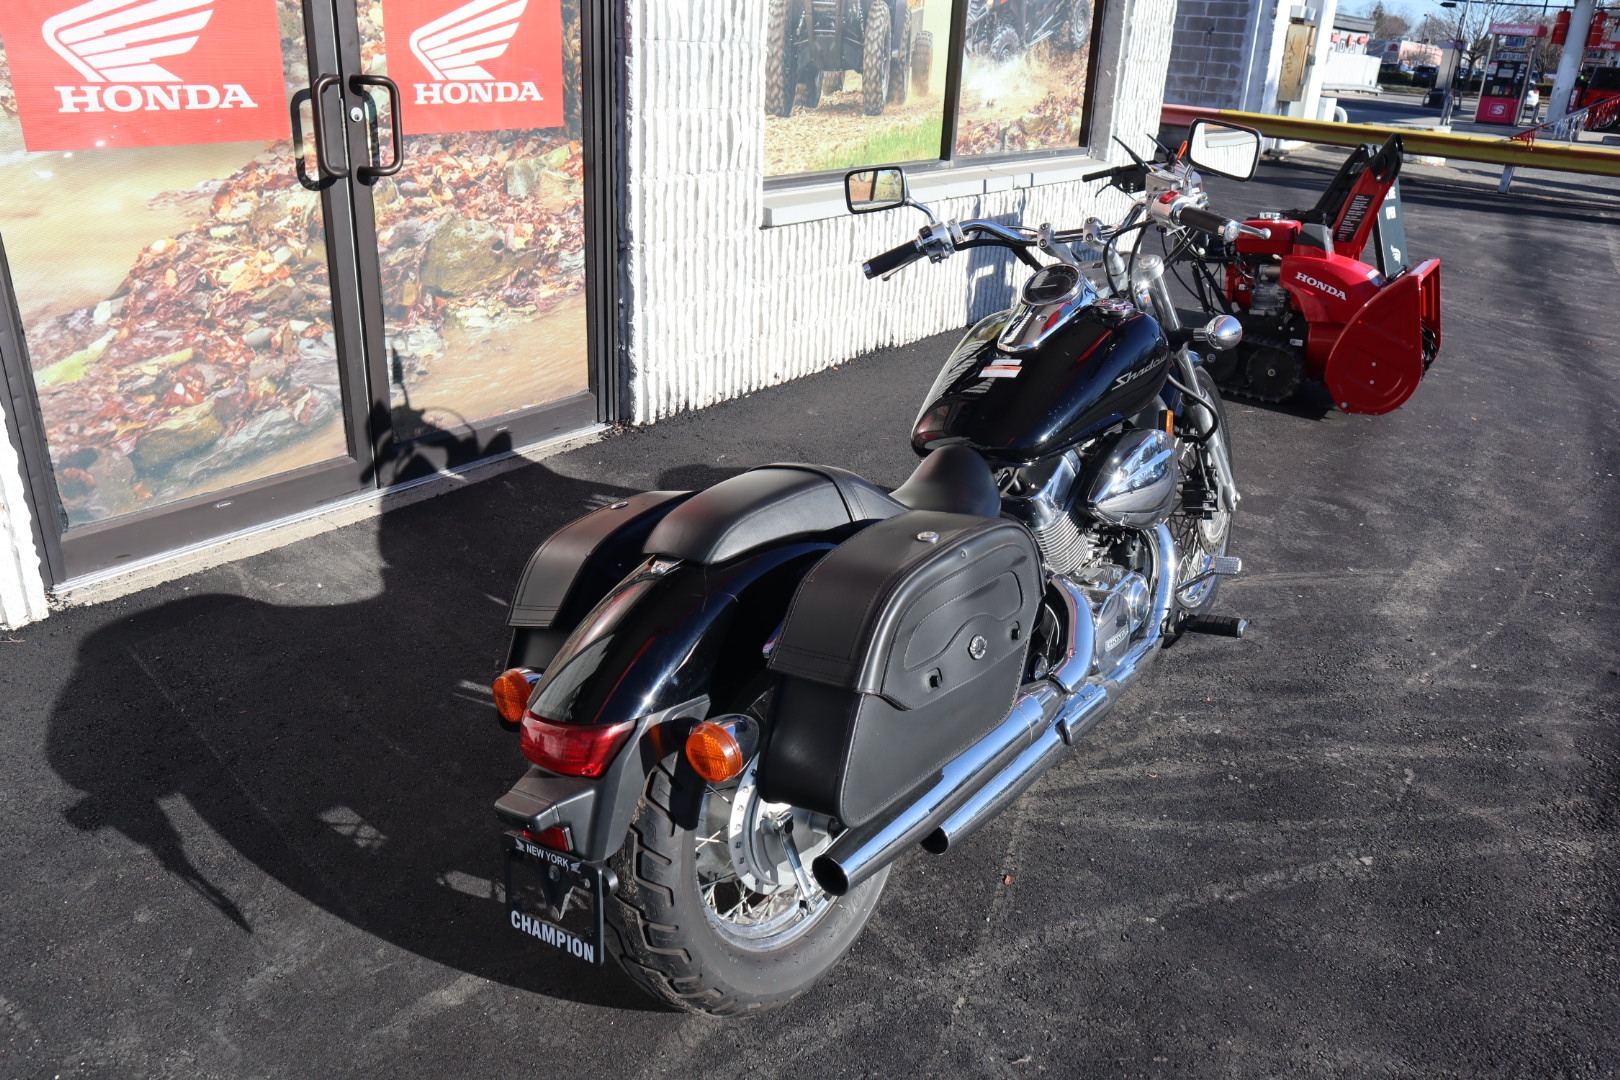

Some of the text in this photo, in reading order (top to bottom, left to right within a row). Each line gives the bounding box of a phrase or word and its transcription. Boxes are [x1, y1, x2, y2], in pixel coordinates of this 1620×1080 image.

[53, 83, 259, 113] HONDA
[413, 81, 545, 105] HONDA
[1295, 271, 1347, 301] HONDA
[526, 843, 569, 871] NEW YORK
[510, 910, 595, 964] CHAMPION
